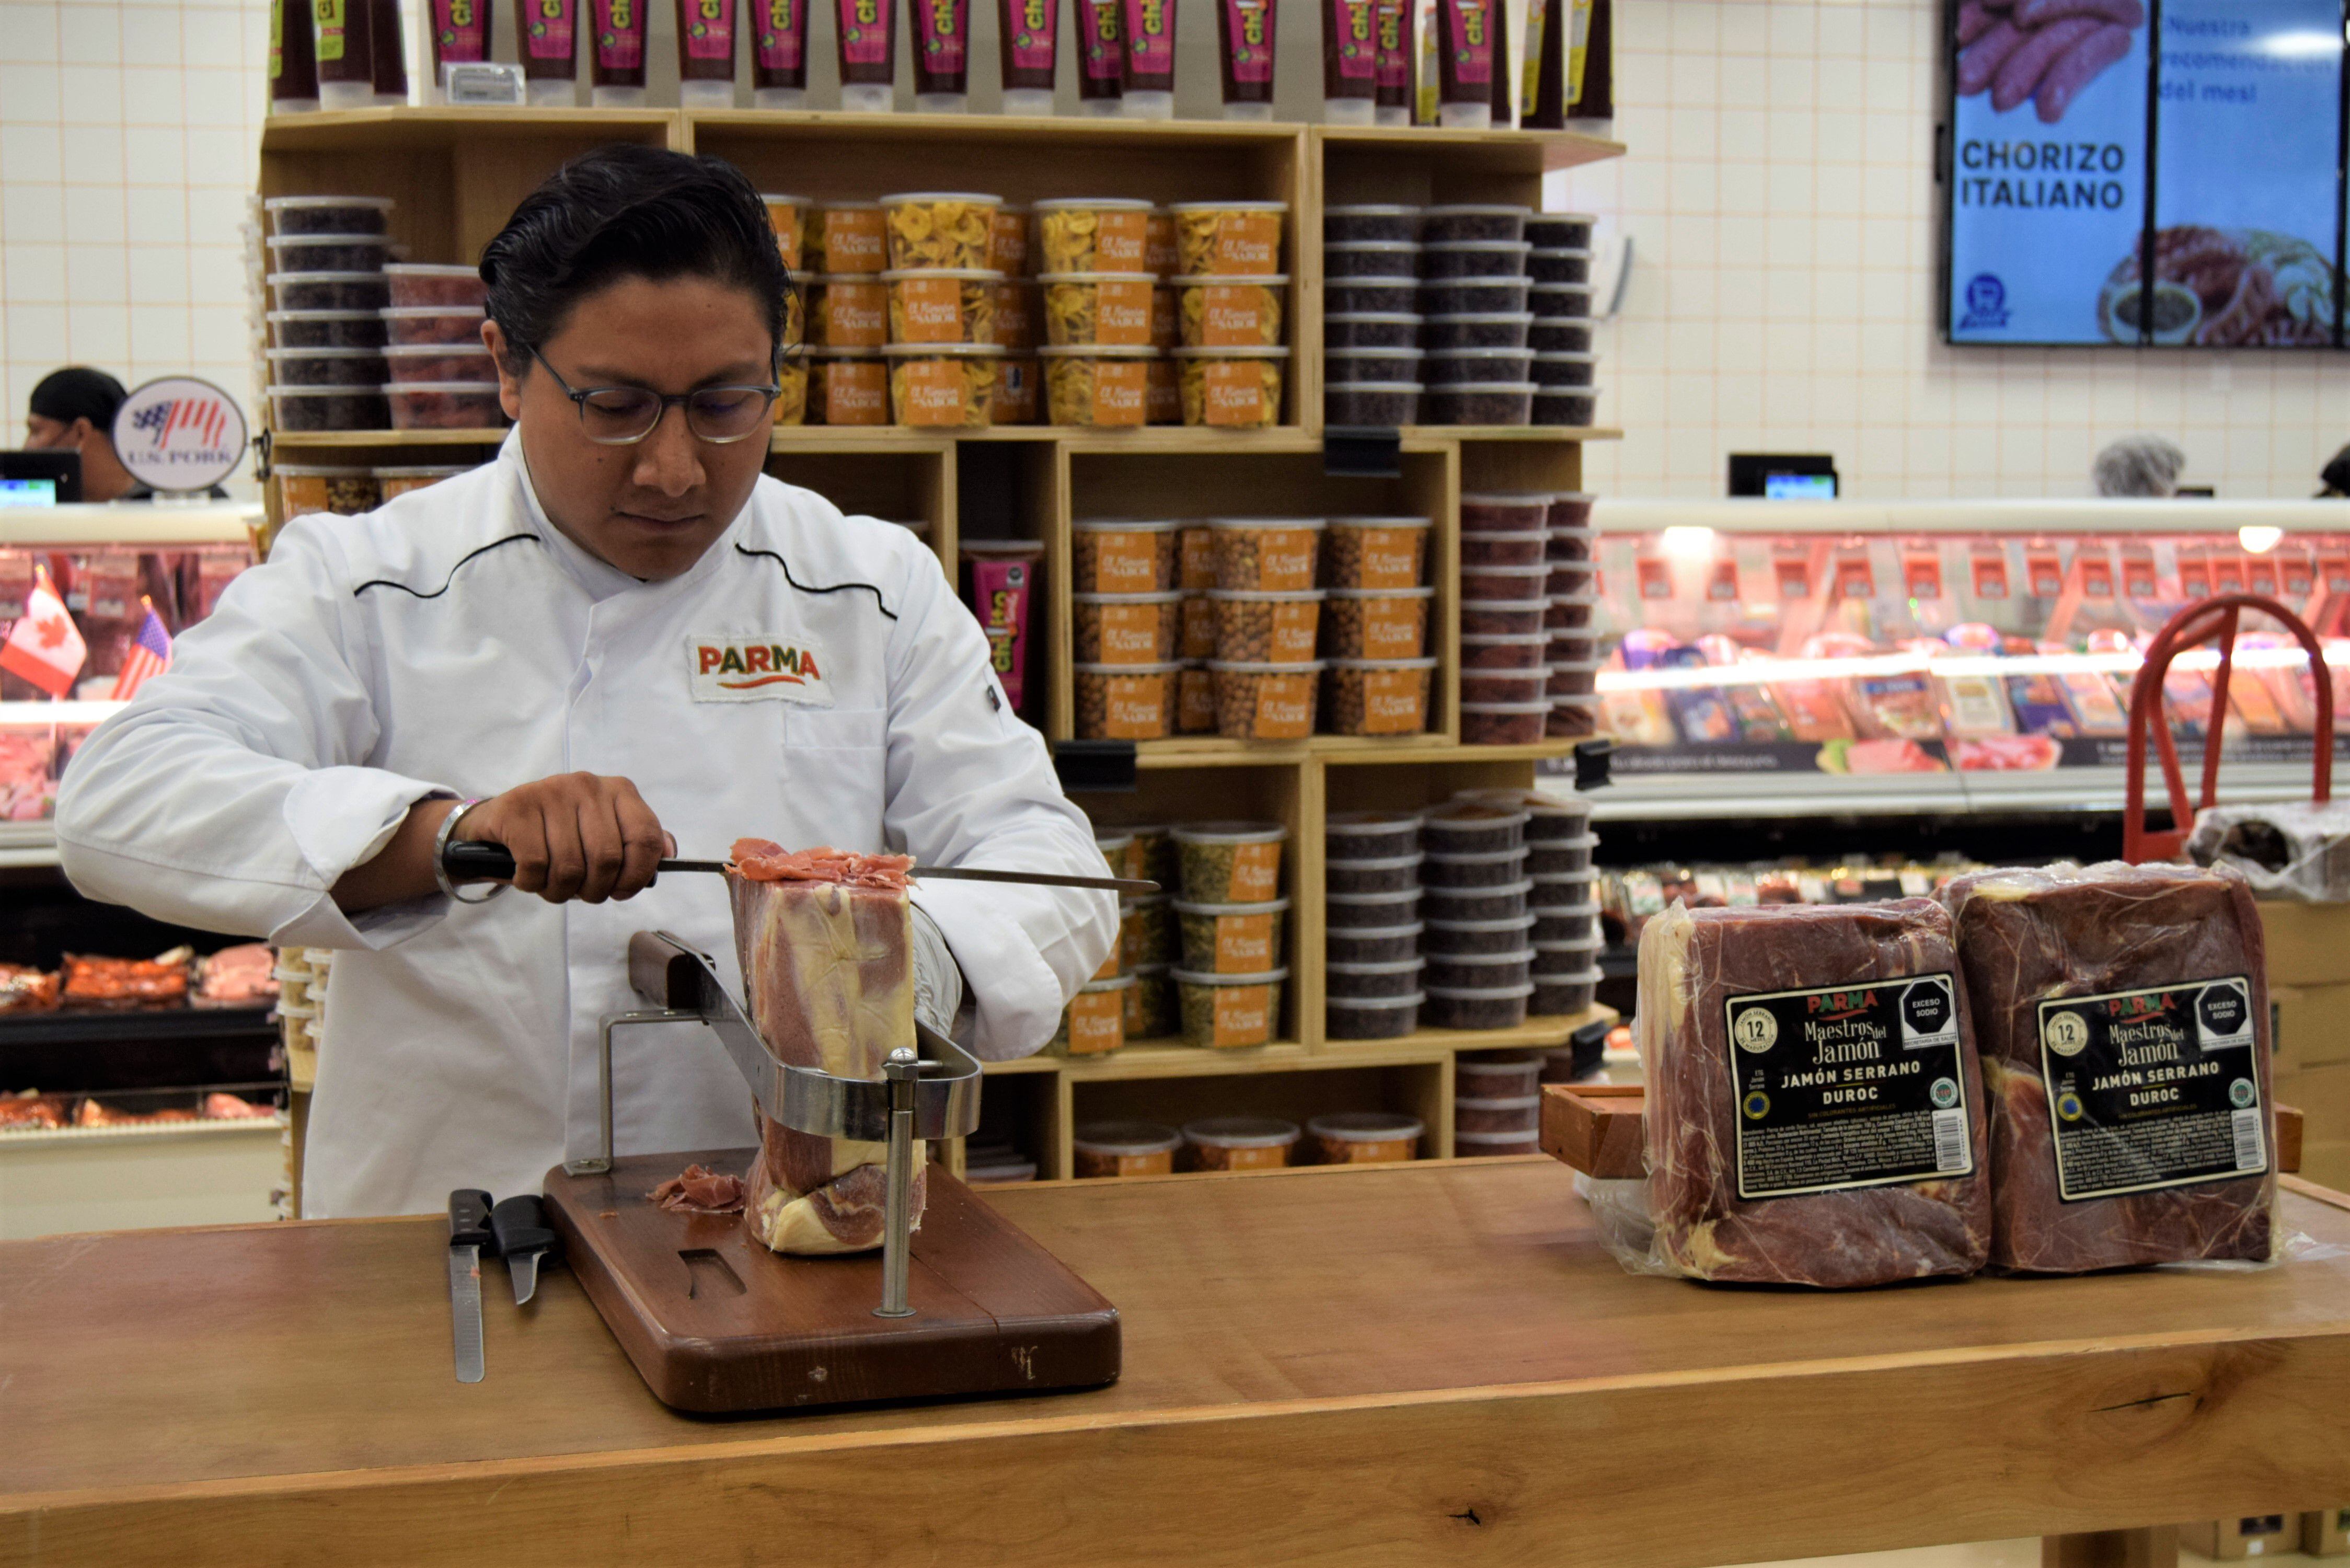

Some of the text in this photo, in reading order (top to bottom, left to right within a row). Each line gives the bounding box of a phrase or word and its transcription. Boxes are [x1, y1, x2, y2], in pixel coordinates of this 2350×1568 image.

[1961, 140, 2125, 174] CHORIZO
[1962, 179, 2125, 210] ITALIANO
[698, 644, 821, 680] PARMA
[1807, 989, 1879, 1013] PARMA
[1913, 998, 1940, 1008] EXCESO
[2109, 993, 2176, 1017] PARMA
[2207, 1001, 2237, 1011] EXCESO
[1916, 1009, 1938, 1018] SODIO
[2212, 1010, 2235, 1019] SODIO
[1748, 1021, 1764, 1037] 12
[1804, 1020, 1887, 1042] Maestros del
[2058, 1024, 2074, 1042] 12
[2109, 1023, 2184, 1044] Maestros del
[1813, 1038, 1881, 1065] Jamón
[2118, 1040, 2179, 1067] Jamón
[1781, 1060, 1921, 1089] JAMÓN SERRANO
[2092, 1071, 2142, 1091] JAMÓN
[2147, 1062, 2219, 1082] SERRANO
[1823, 1088, 1879, 1105] DUROC
[2130, 1087, 2180, 1106] DUROC
